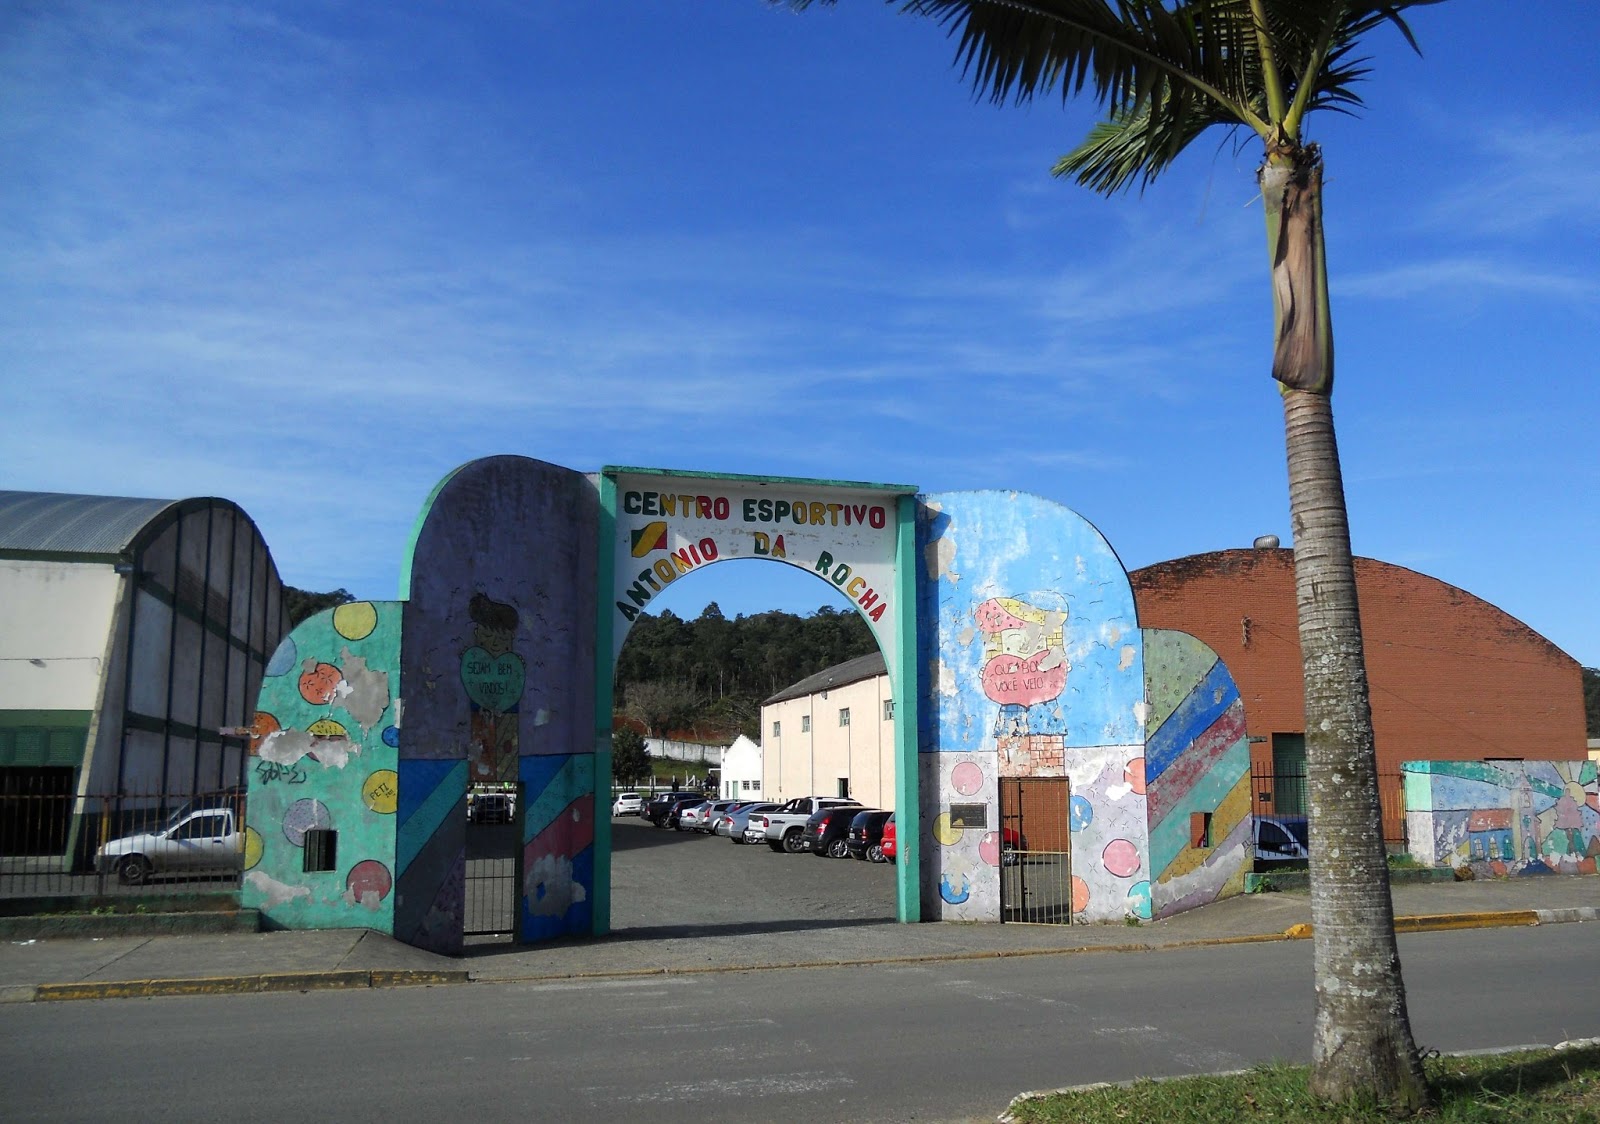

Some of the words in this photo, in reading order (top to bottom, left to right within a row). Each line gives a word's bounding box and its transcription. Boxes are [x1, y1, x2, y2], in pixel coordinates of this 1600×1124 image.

[624, 491, 730, 520] CENTRO
[742, 498, 886, 529] ESPORTIVO
[616, 537, 719, 622] ANTONIO
[754, 532, 787, 558] DA
[815, 550, 887, 622] ROCHA
[467, 662, 491, 675] SEJAM
[497, 663, 513, 676] BEM
[995, 677, 1018, 692] VOCÊ
[1023, 677, 1044, 690] VEIO
[369, 782, 390, 800] PETI
